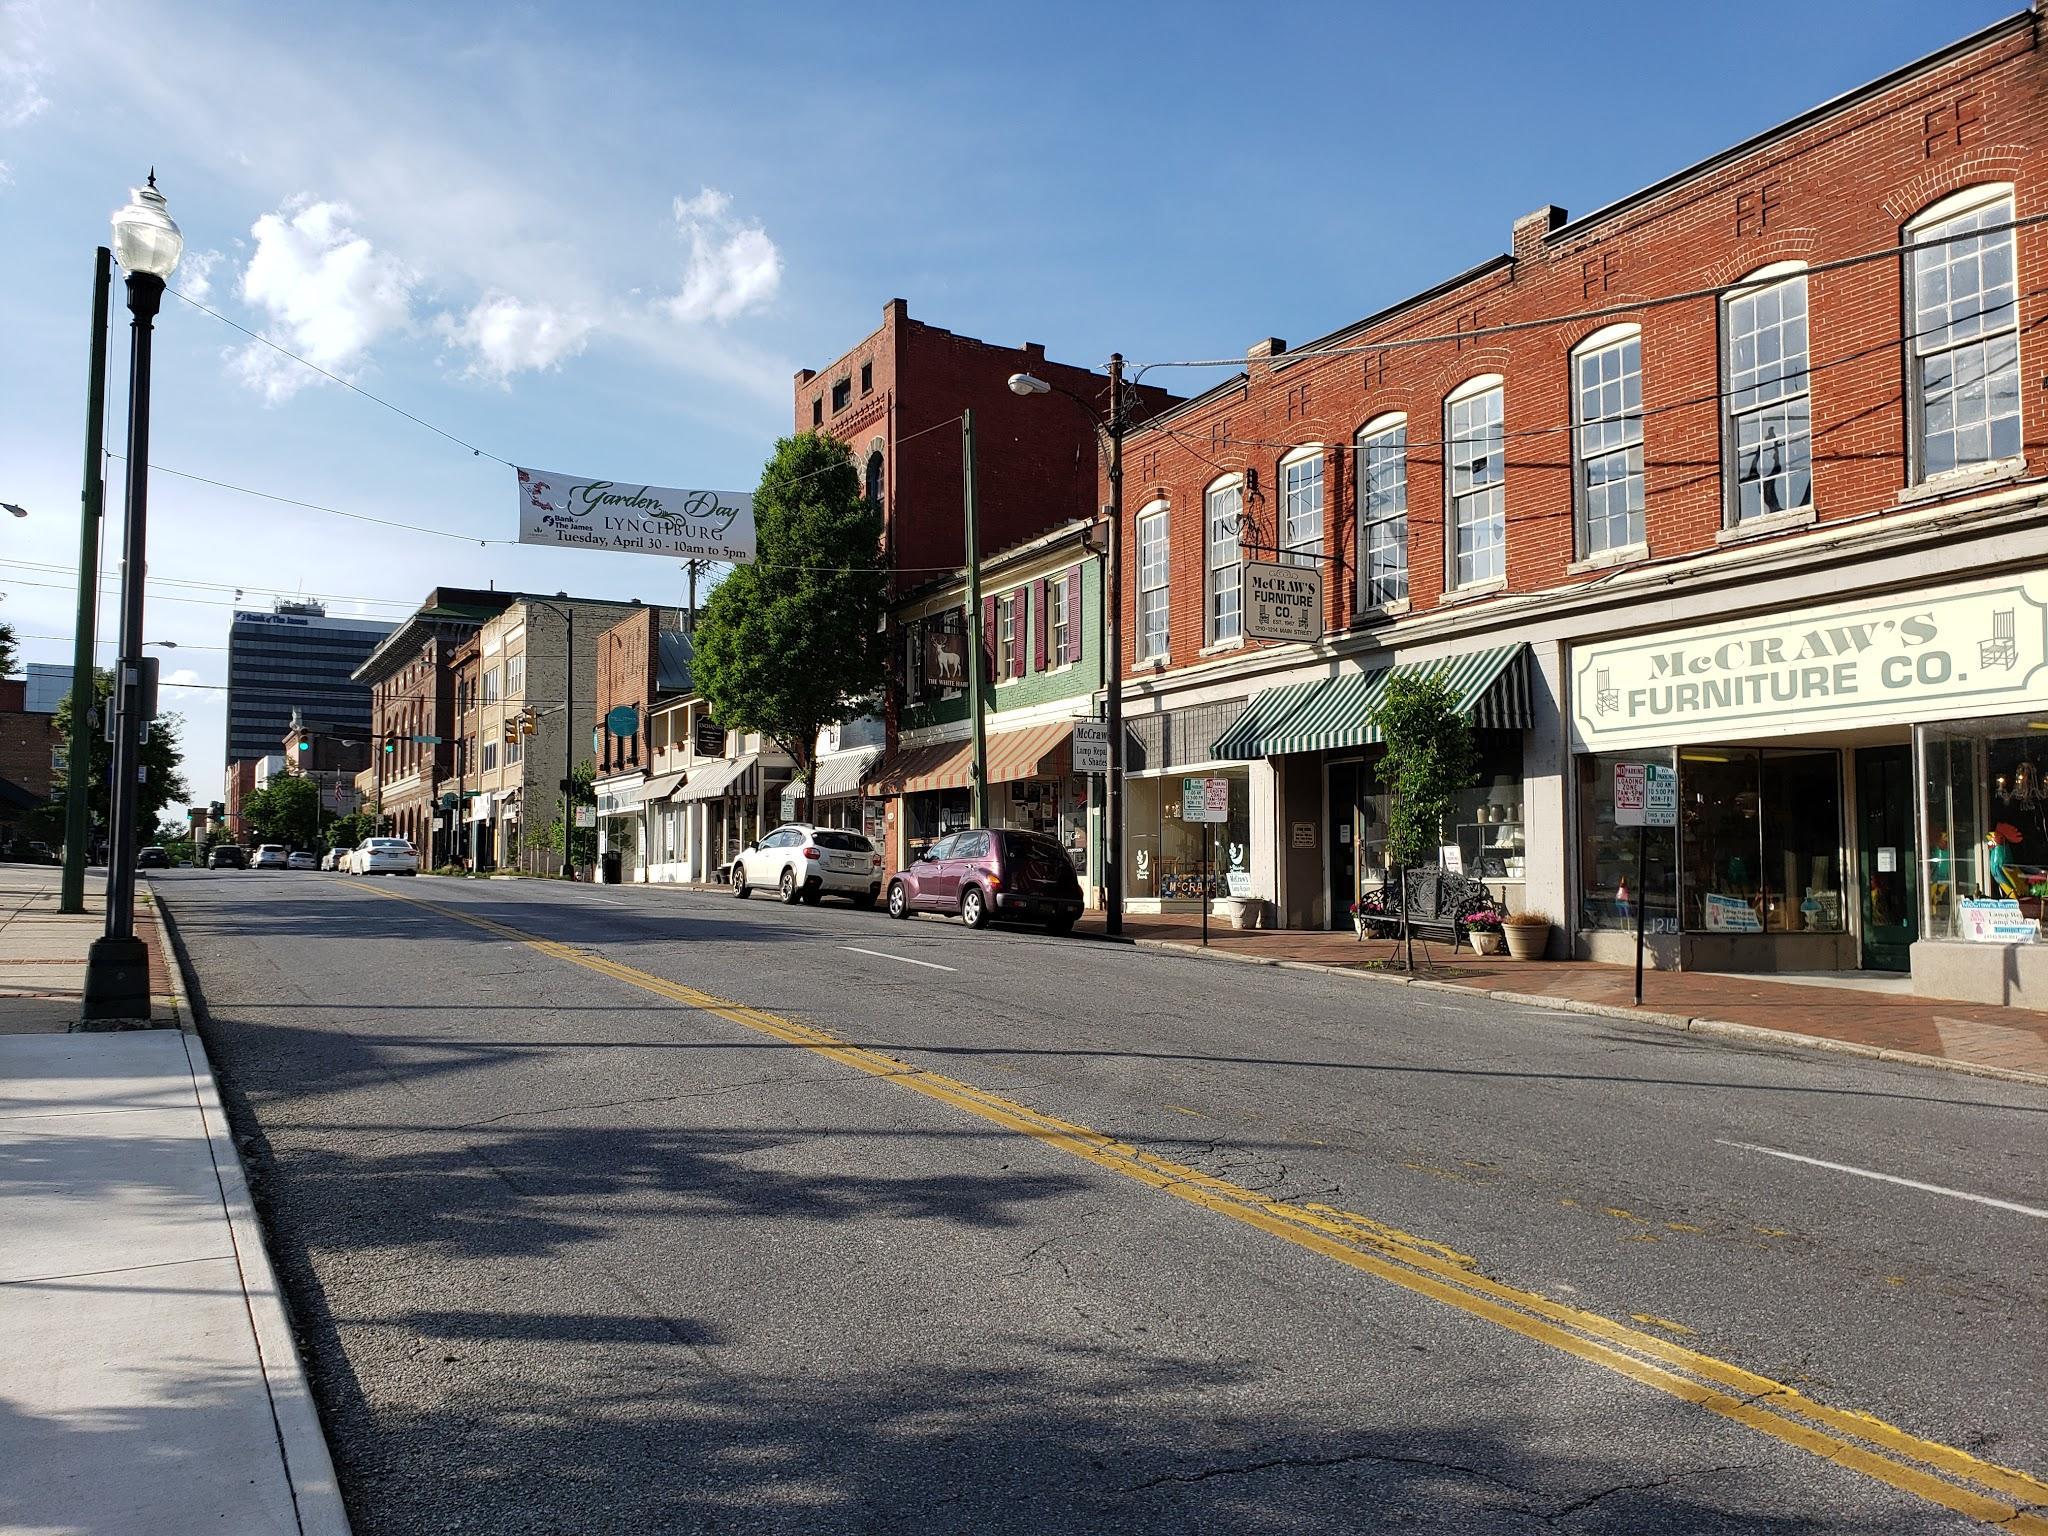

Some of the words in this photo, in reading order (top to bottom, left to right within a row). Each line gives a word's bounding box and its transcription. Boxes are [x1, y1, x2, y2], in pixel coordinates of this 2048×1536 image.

[568, 481, 672, 518] Garden
[684, 490, 739, 531] Day
[554, 515, 574, 523] Bank
[555, 522, 569, 530] The
[570, 523, 593, 531] James
[604, 516, 723, 541] LYNCHBURG
[555, 529, 609, 547] Tuesday,
[613, 534, 644, 549] April
[647, 538, 662, 549] 30
[674, 541, 704, 554] 10am
[708, 547, 719, 556] to
[722, 546, 746, 559] 5pm
[1252, 576, 1315, 595] McCRAW'S
[1254, 590, 1313, 607] FURNITURE
[1275, 606, 1293, 618] CO.
[1648, 611, 1939, 681] McCRAW'S
[1627, 661, 1859, 718] FURNITURE
[1880, 650, 1968, 690] CO.
[1076, 728, 1107, 740] McCraw
[1076, 746, 1091, 756] Lamp
[1093, 746, 1107, 757] Repa
[1082, 758, 1086, 766] &
[1617, 766, 1625, 776] NO
